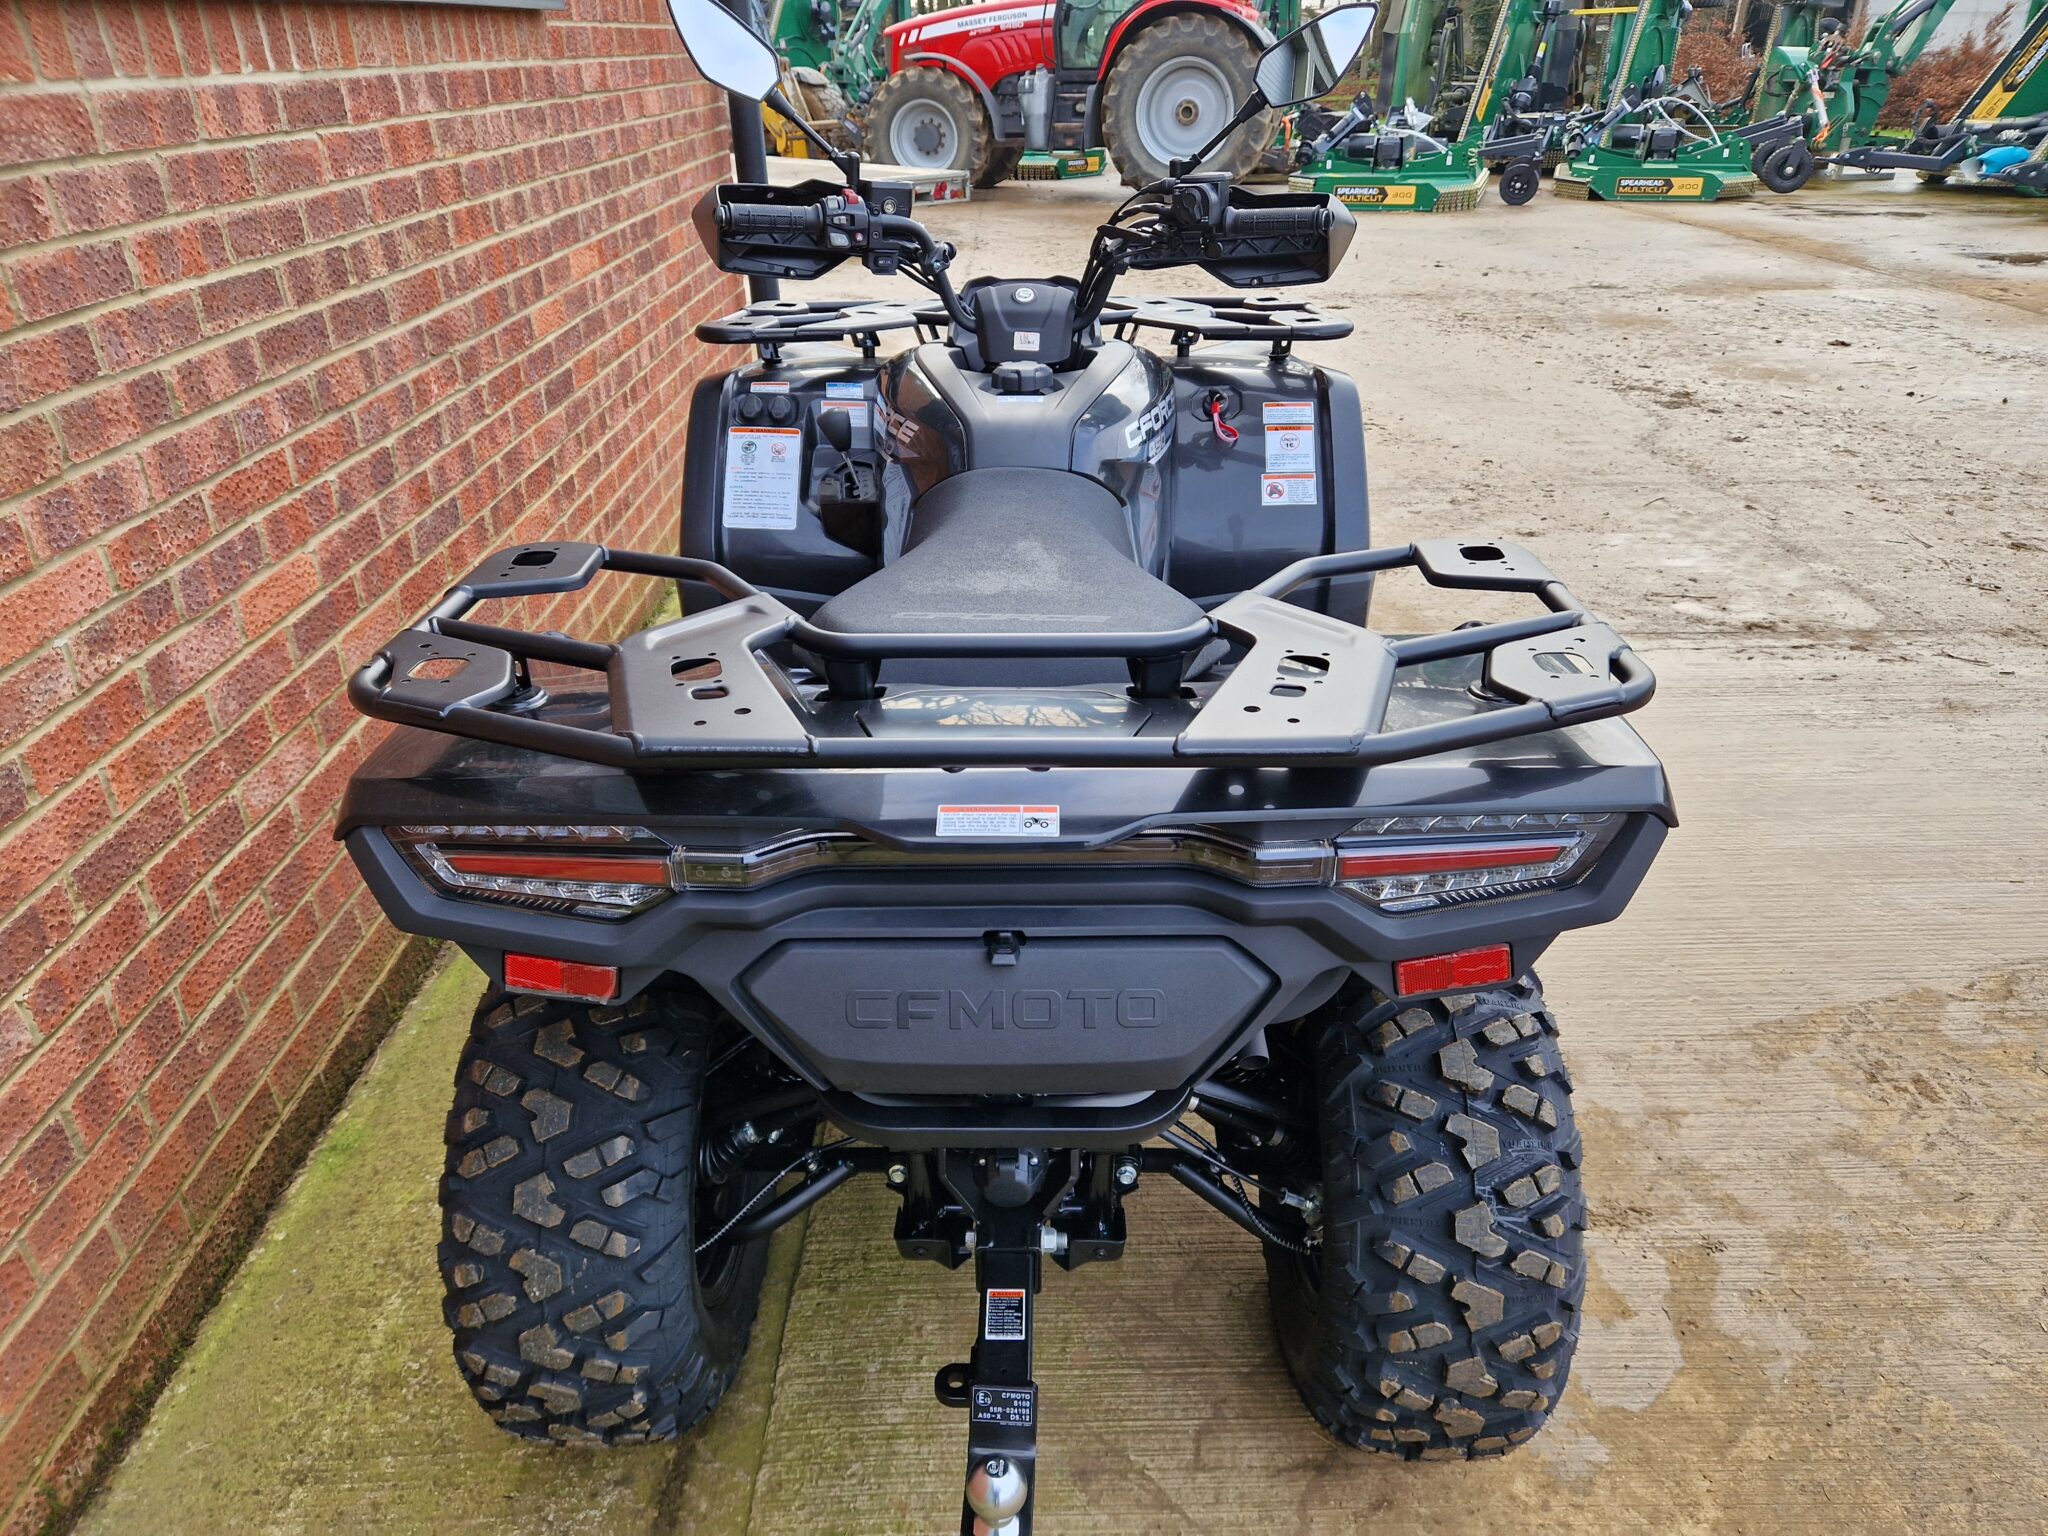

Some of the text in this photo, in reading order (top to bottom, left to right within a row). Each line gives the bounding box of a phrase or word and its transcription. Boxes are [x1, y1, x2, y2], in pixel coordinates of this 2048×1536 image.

[957, 12, 1028, 28] MASSEY FERGUSON
[1619, 179, 1665, 187] SPEARHEAD
[1336, 187, 1380, 195] SPEARHEAD
[1337, 194, 1384, 202] MULTICUT
[845, 989, 1167, 1030] CFMOTO
[1001, 1392, 1031, 1400] CFMOTO
